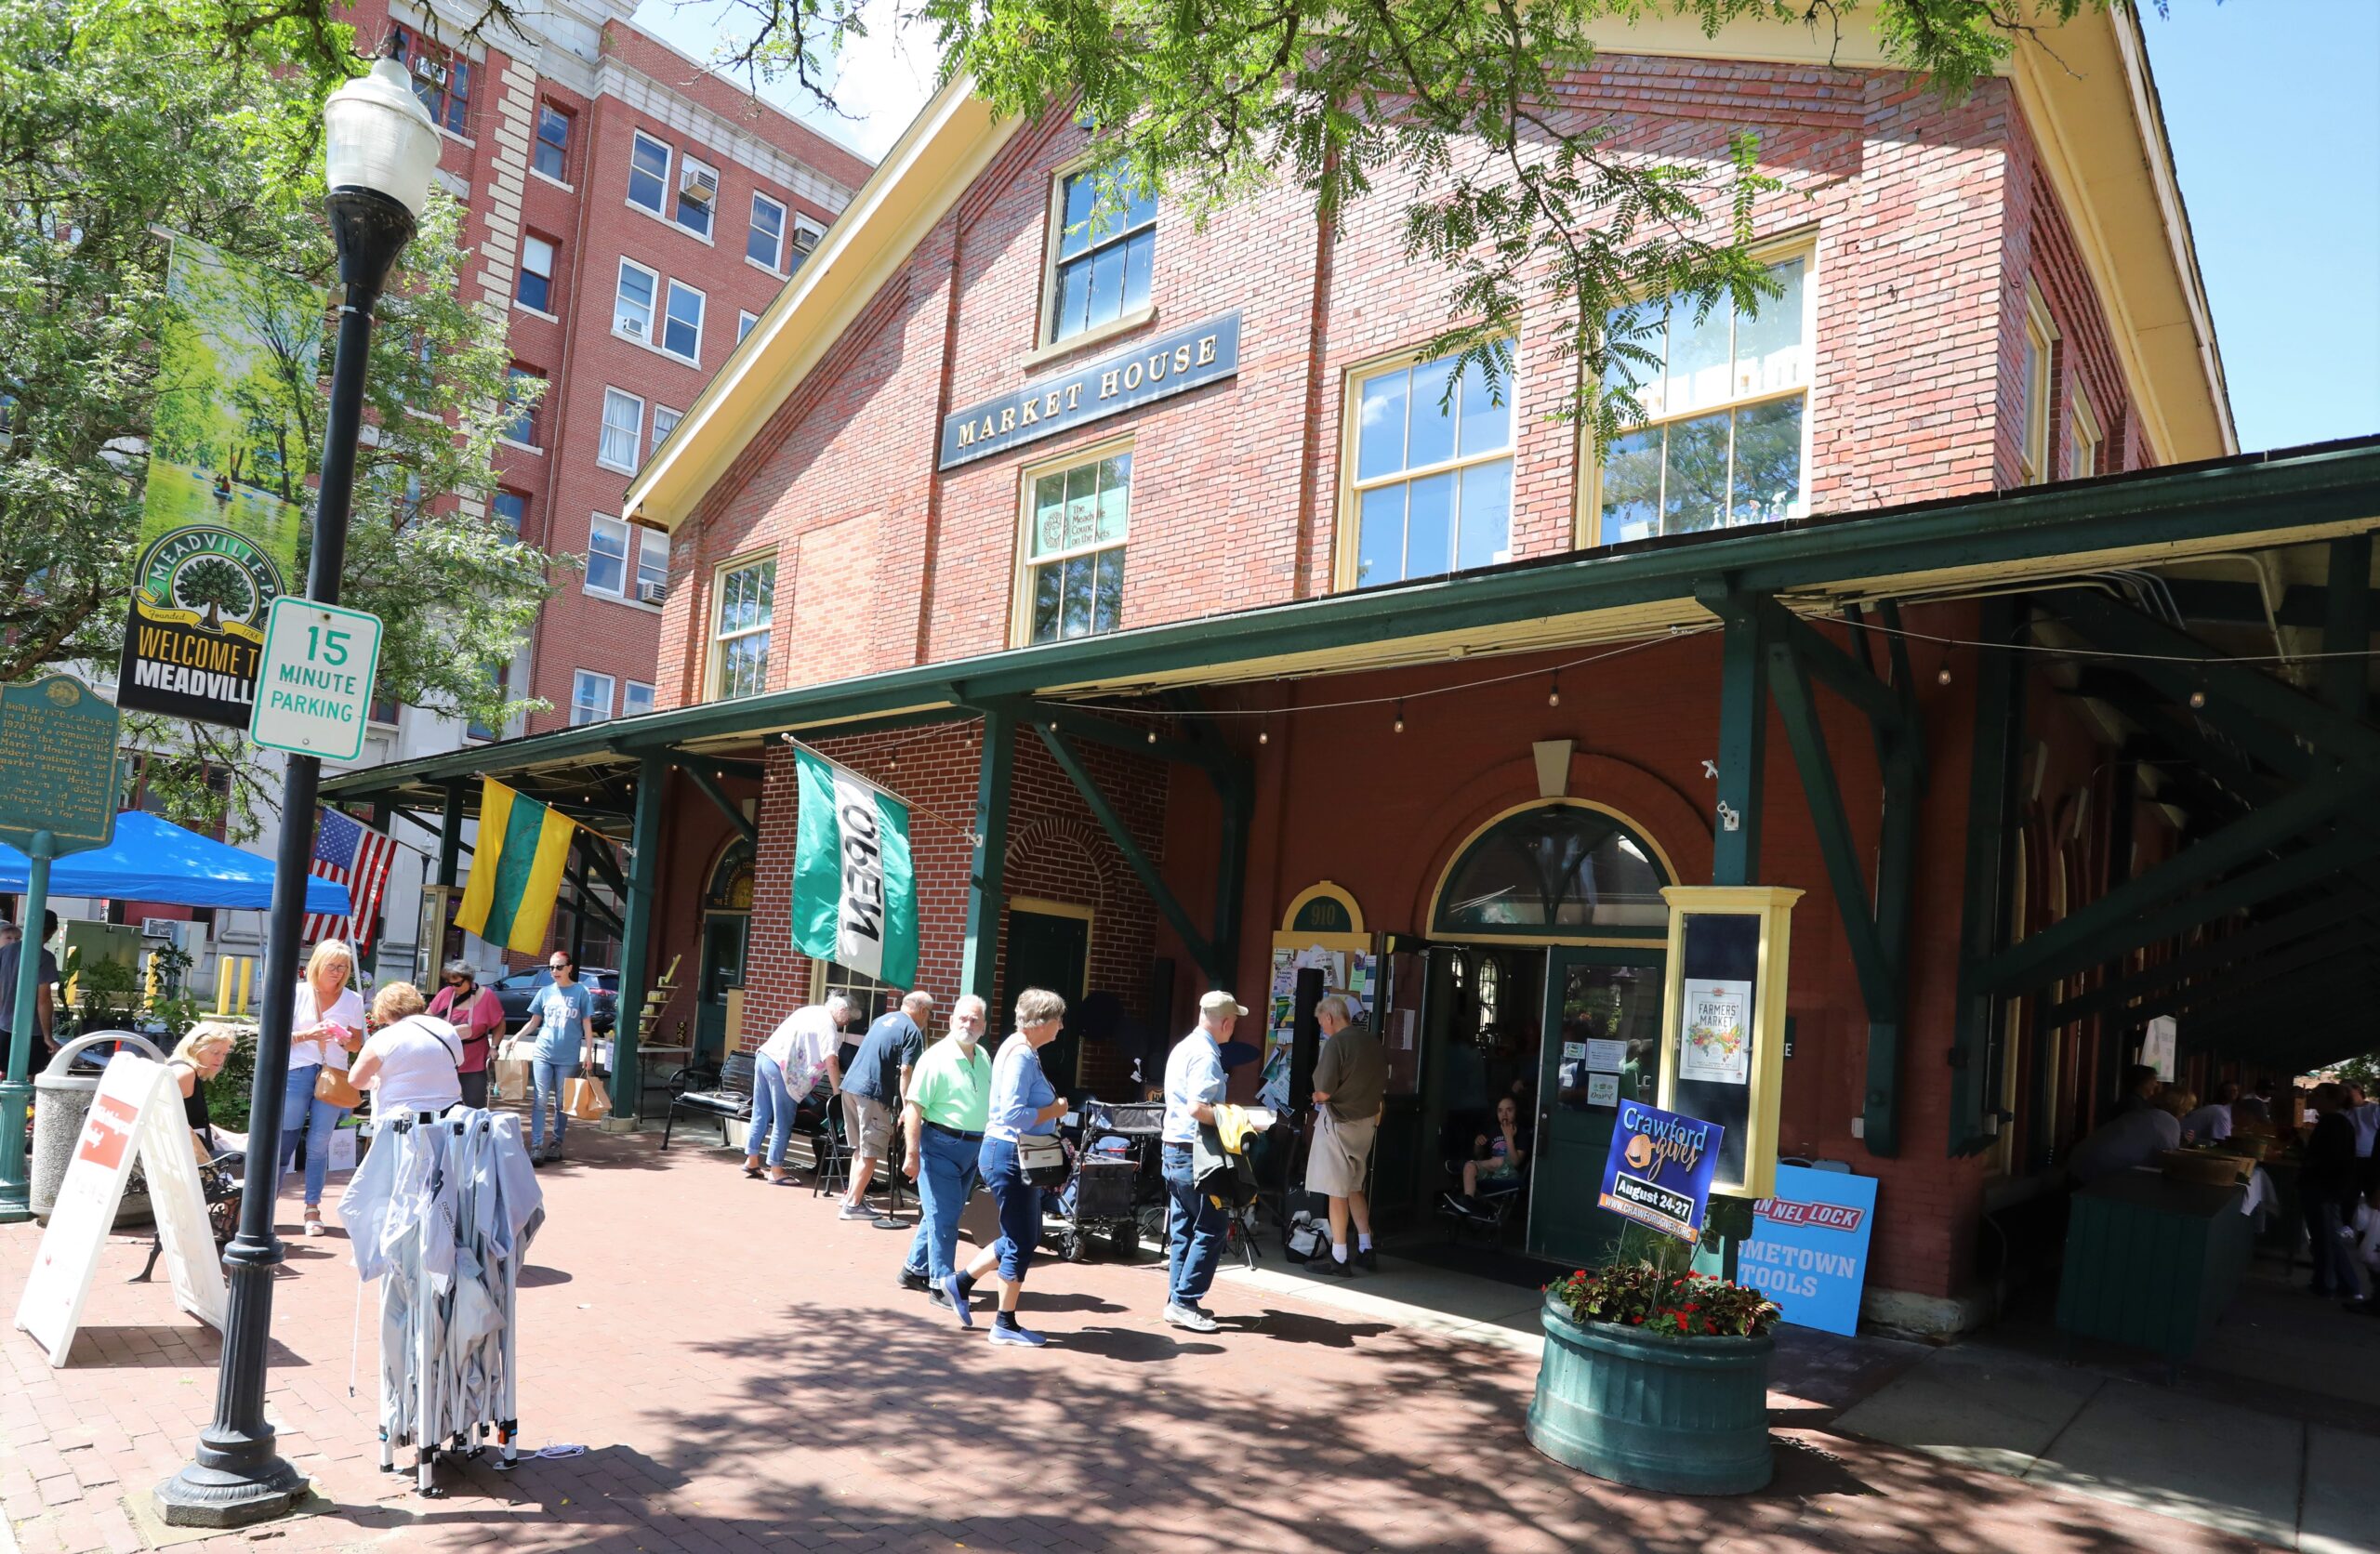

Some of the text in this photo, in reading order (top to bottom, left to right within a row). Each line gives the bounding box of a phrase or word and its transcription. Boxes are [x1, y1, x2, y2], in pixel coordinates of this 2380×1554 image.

[957, 333, 1219, 449] MARKET HOUSE
[1072, 505, 1085, 515] The
[1072, 508, 1106, 523] Meadvle
[1071, 523, 1094, 535] Counc
[1071, 536, 1080, 546] on
[1081, 533, 1093, 543] the
[150, 533, 266, 583] MEADVILLE
[148, 609, 259, 640] Founded 1788
[139, 625, 258, 678] WELCOME T
[307, 626, 351, 666] 15
[134, 658, 253, 705] MEADVILL
[279, 663, 357, 695] MINUTE
[271, 690, 353, 722] PARKING
[3, 719, 27, 731] 1970
[29, 724, 43, 735] by
[37, 734, 55, 744] the
[1312, 904, 1336, 926] 910
[1699, 1003, 1739, 1016] FARMERS'
[1699, 1015, 1734, 1027] MARKET
[1623, 1107, 1709, 1152] Crawford
[1646, 1133, 1698, 1181] gives
[1618, 1179, 1690, 1218] August 24-27
[1605, 1196, 1692, 1239] WWW.CRAWFORDGIVES.ORG
[1738, 1239, 1857, 1279] METOWN
[1739, 1263, 1818, 1297] TOOLS
